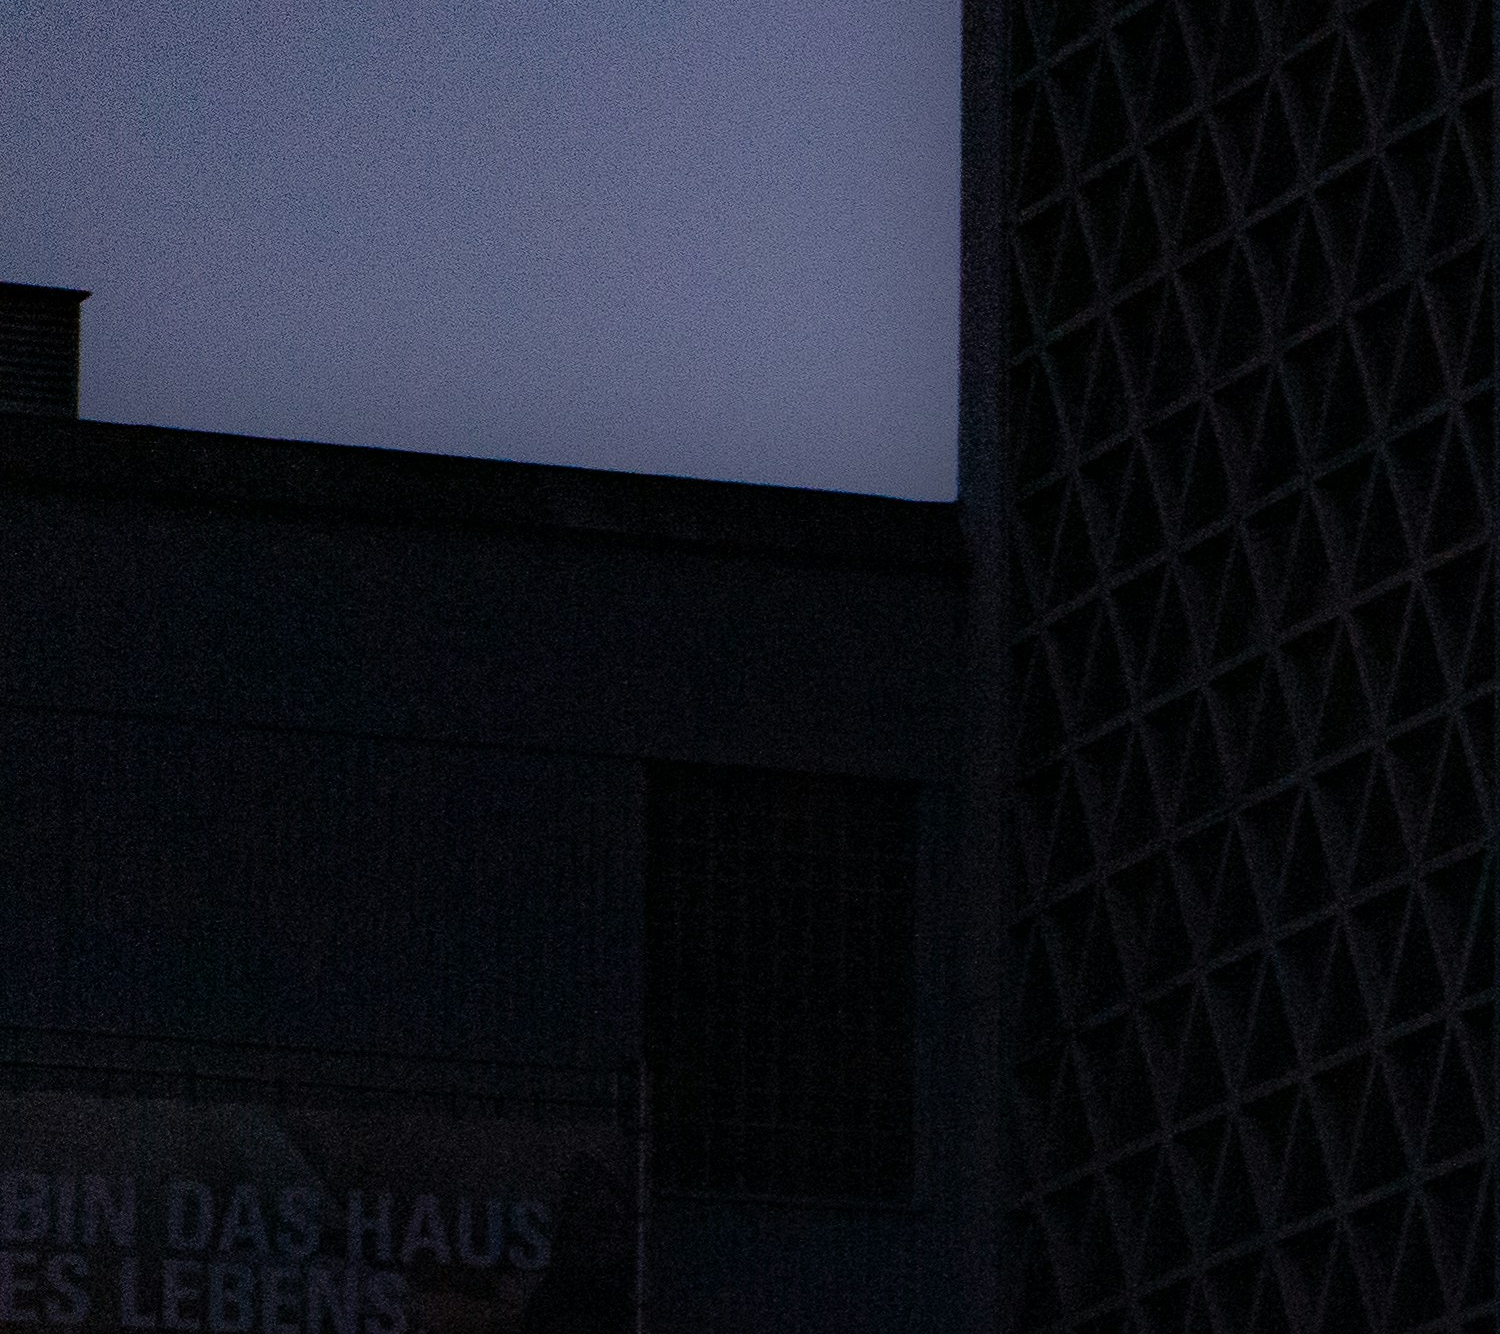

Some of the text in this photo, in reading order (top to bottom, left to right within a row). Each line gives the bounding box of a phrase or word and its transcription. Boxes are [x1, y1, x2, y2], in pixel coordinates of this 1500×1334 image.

[0, 1170, 552, 1270] BIN DAS HAUS
